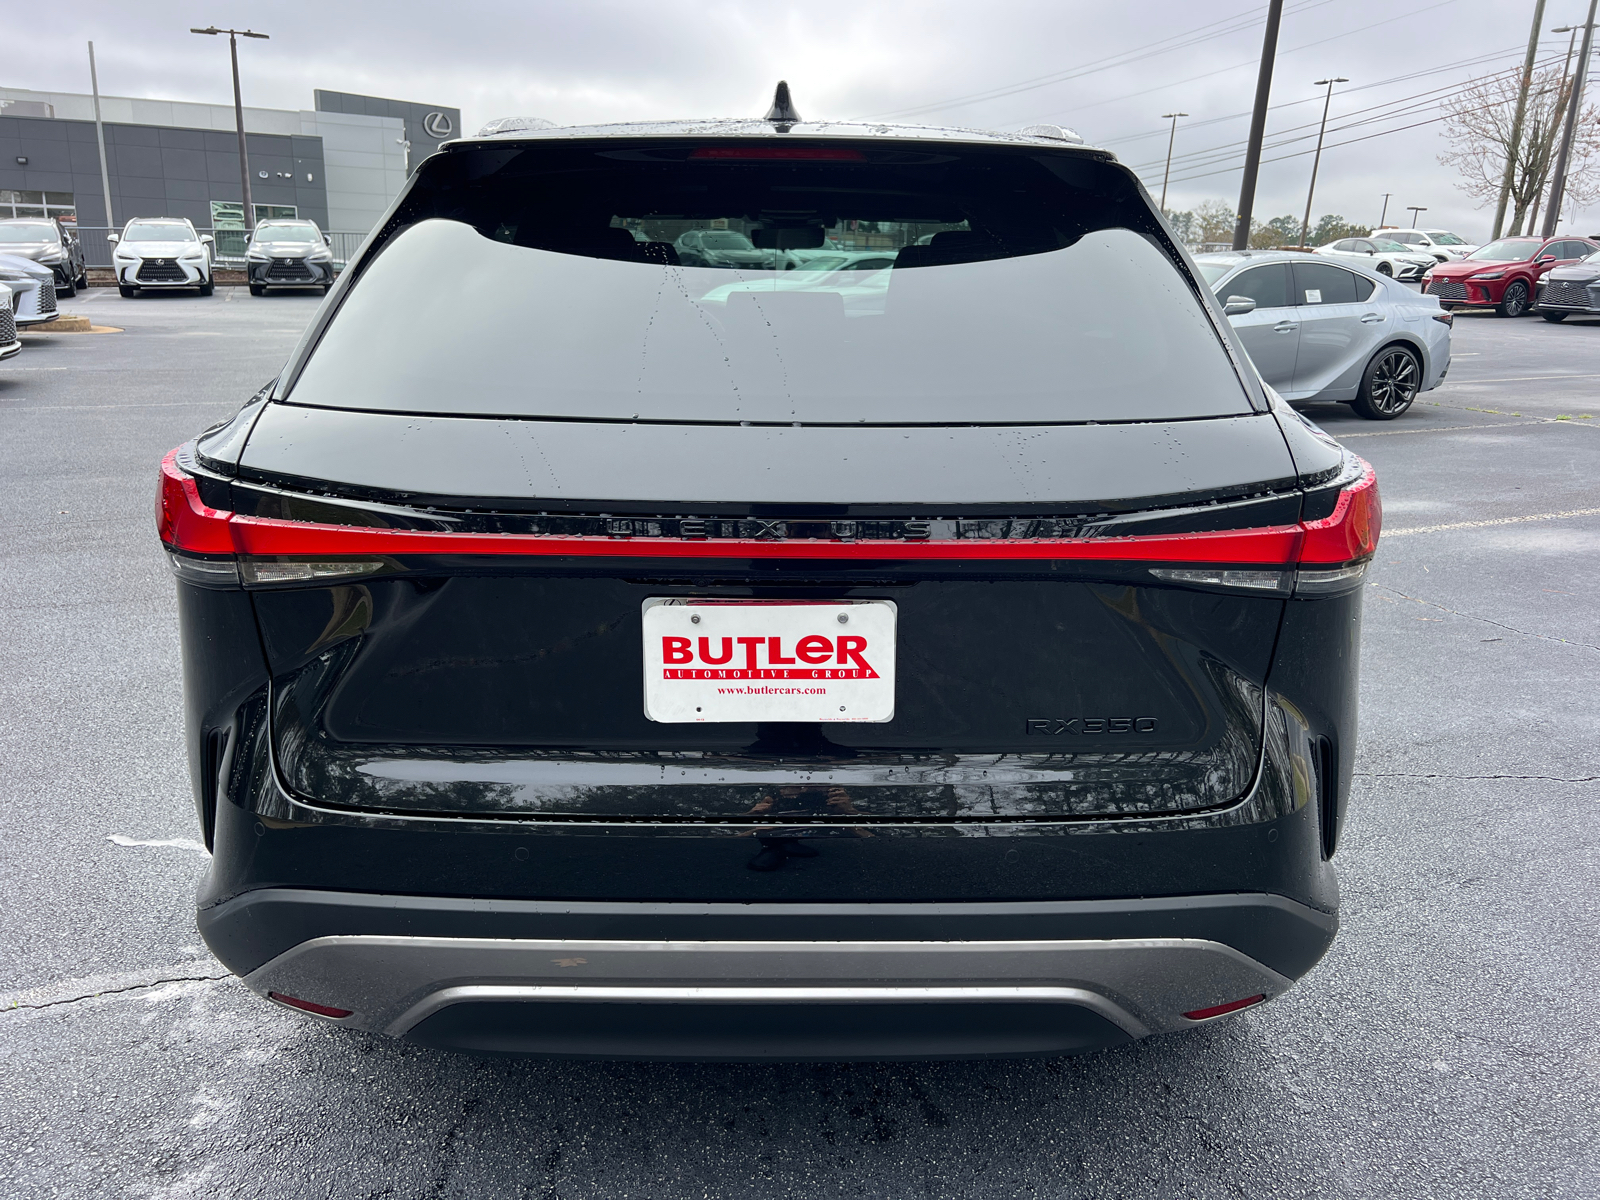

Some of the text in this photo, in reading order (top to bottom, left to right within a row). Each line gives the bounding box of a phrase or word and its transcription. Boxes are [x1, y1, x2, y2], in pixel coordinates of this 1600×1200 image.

[606, 518, 931, 539] LEXUS
[664, 669, 872, 679] AUTOMOTIVE GROUP
[717, 685, 827, 695] www.butlercars.com
[1026, 717, 1158, 735] RX350
